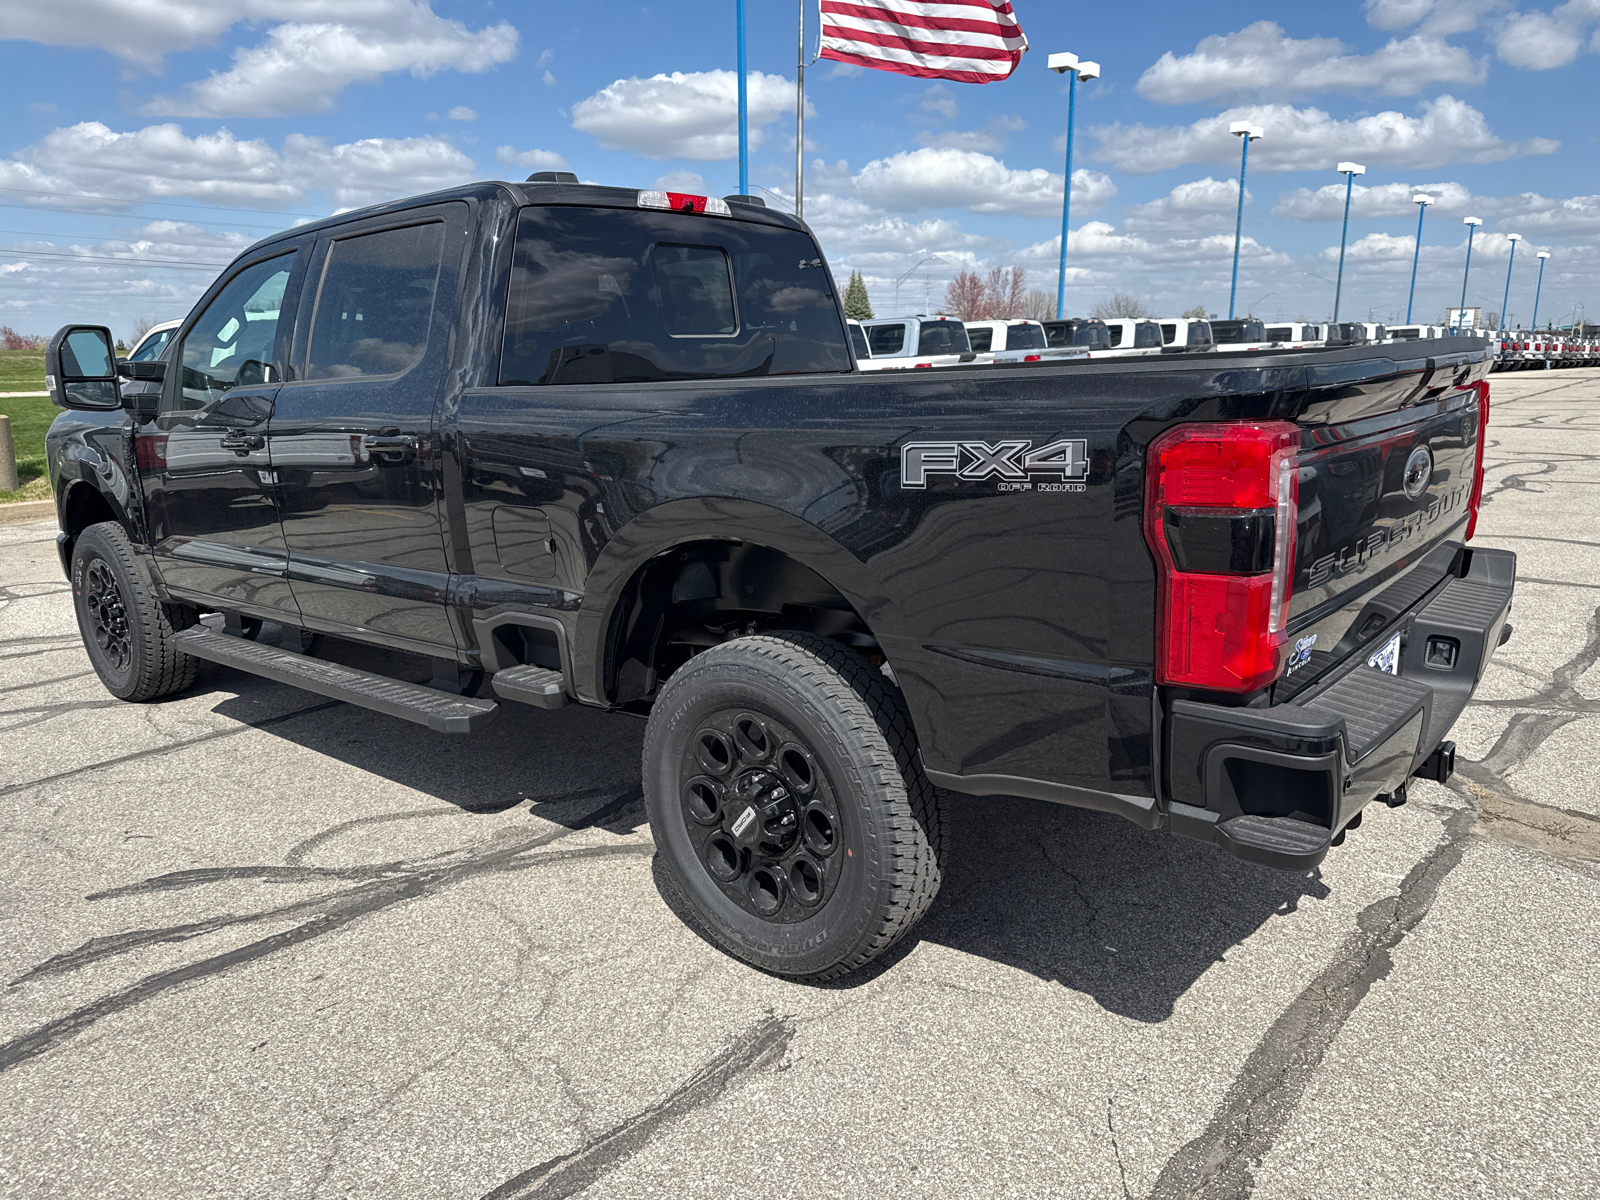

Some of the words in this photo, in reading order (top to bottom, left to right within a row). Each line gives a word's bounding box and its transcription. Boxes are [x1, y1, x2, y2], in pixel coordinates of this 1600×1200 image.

[901, 439, 1090, 489] FX4
[997, 482, 1032, 491] OFF
[1037, 483, 1086, 492] ROAD
[1308, 511, 1423, 590] SUPER
[1427, 478, 1473, 526] DUTY
[734, 811, 751, 832] FORD
